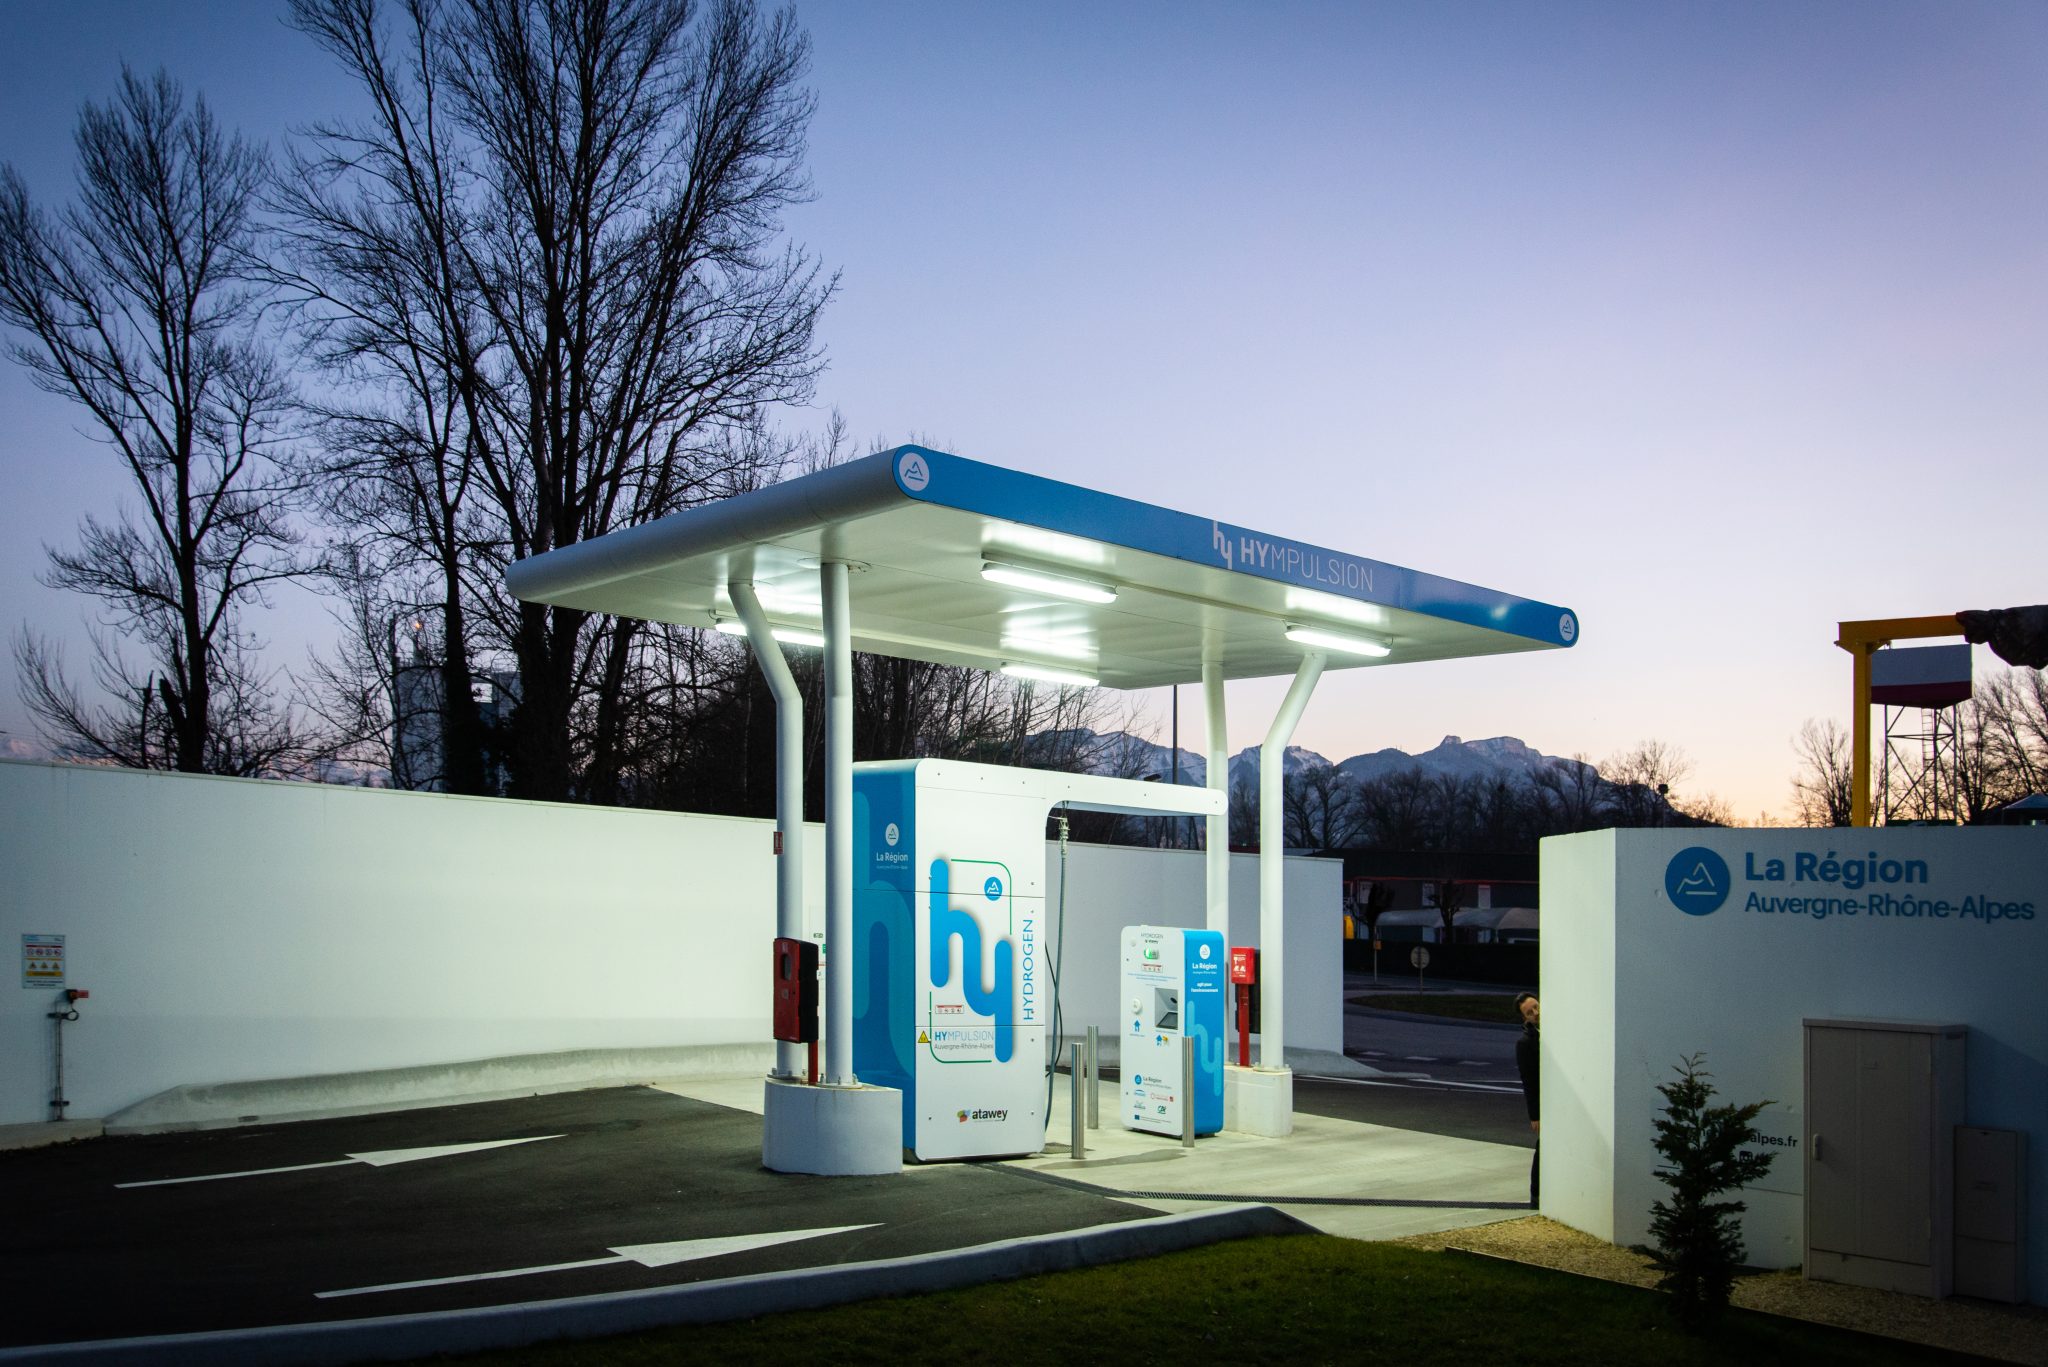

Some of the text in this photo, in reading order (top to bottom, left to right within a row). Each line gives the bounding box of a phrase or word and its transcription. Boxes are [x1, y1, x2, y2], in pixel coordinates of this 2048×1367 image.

[1241, 536, 1373, 592] HYMPULSION
[876, 851, 909, 863] La Région
[1745, 850, 1929, 890] La Région
[1744, 891, 2036, 924] Auvergne-Rhône-Alpes
[1022, 919, 1034, 1020] HYDROGEN
[934, 1031, 994, 1041] HYMPULSION
[972, 1108, 1008, 1121] atawey
